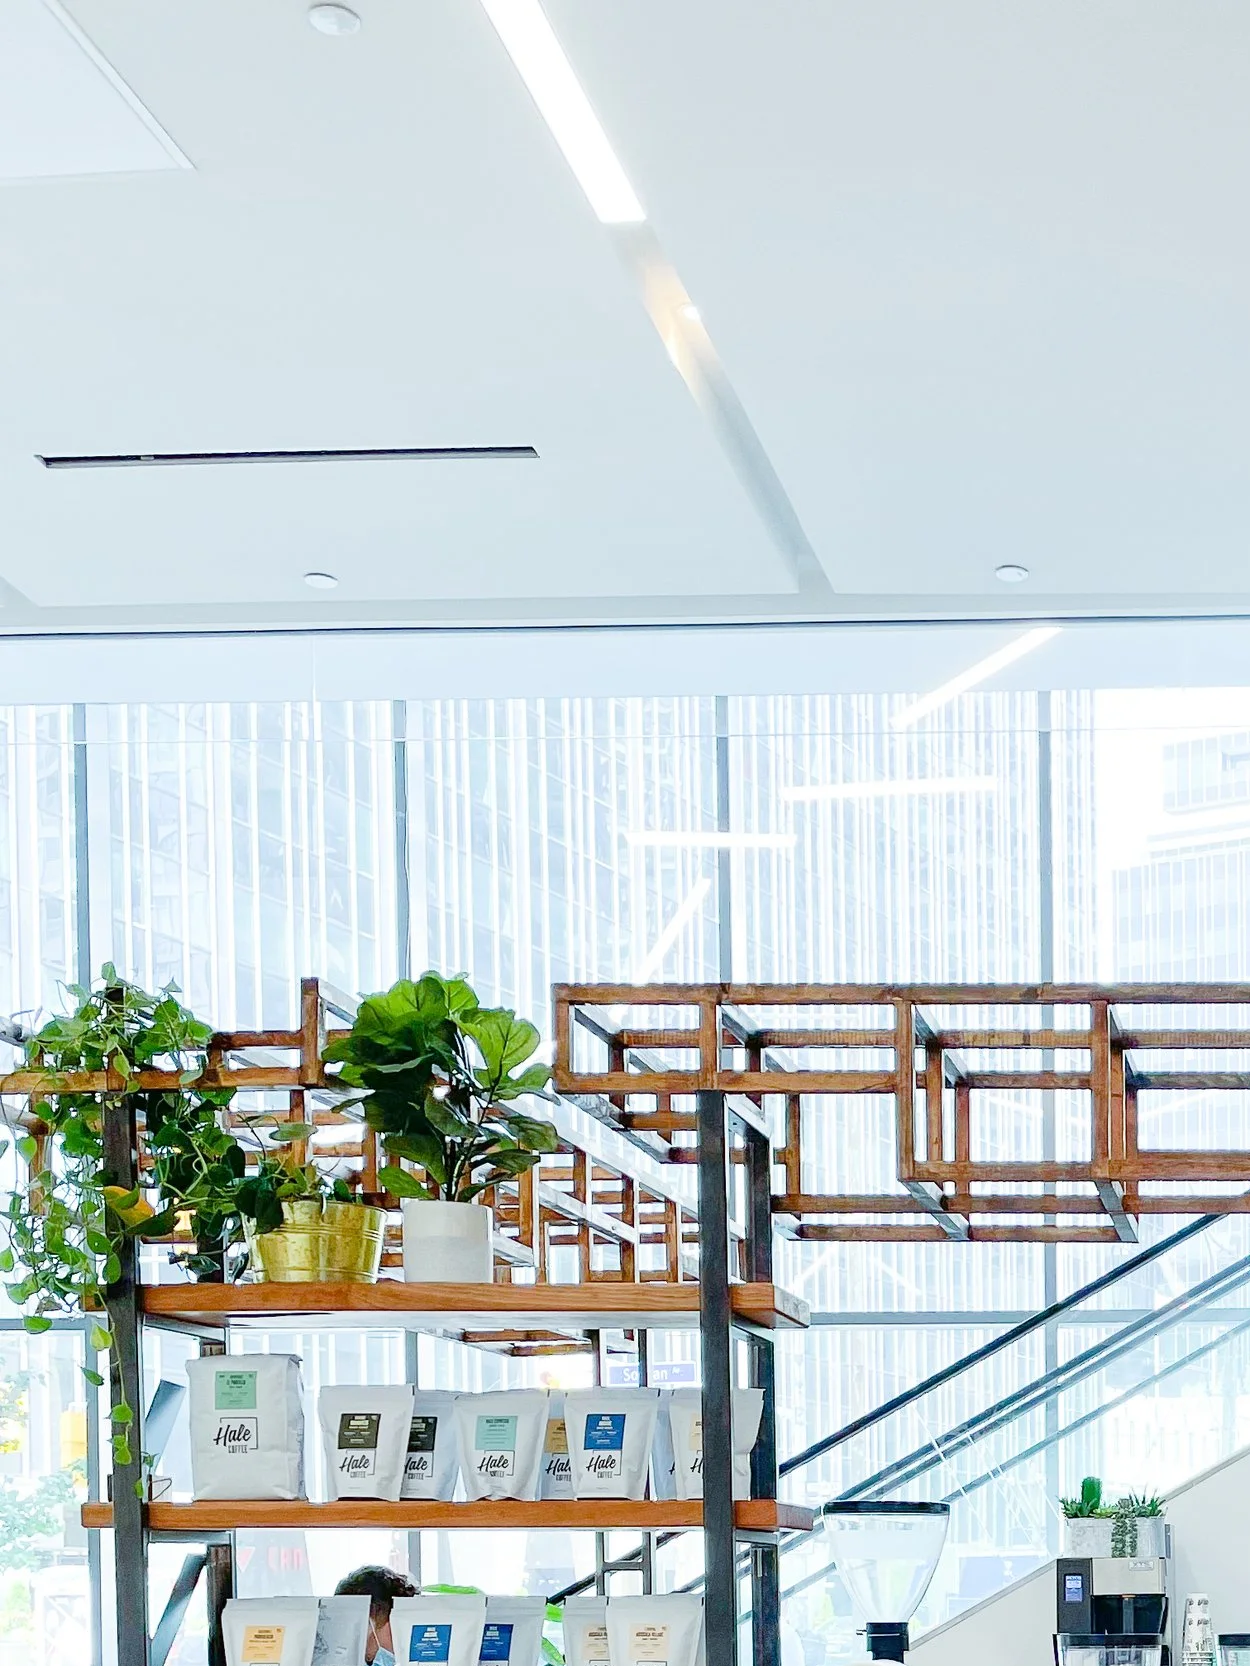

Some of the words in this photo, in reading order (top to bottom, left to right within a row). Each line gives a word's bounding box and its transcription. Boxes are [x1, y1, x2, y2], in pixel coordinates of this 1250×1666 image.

[622, 1367, 669, 1382] Soan
[213, 1424, 252, 1447] Hale
[228, 1445, 248, 1454] COFFEE
[339, 1455, 370, 1473] Hale
[477, 1455, 509, 1472] Hale
[586, 1454, 616, 1472] Hale
